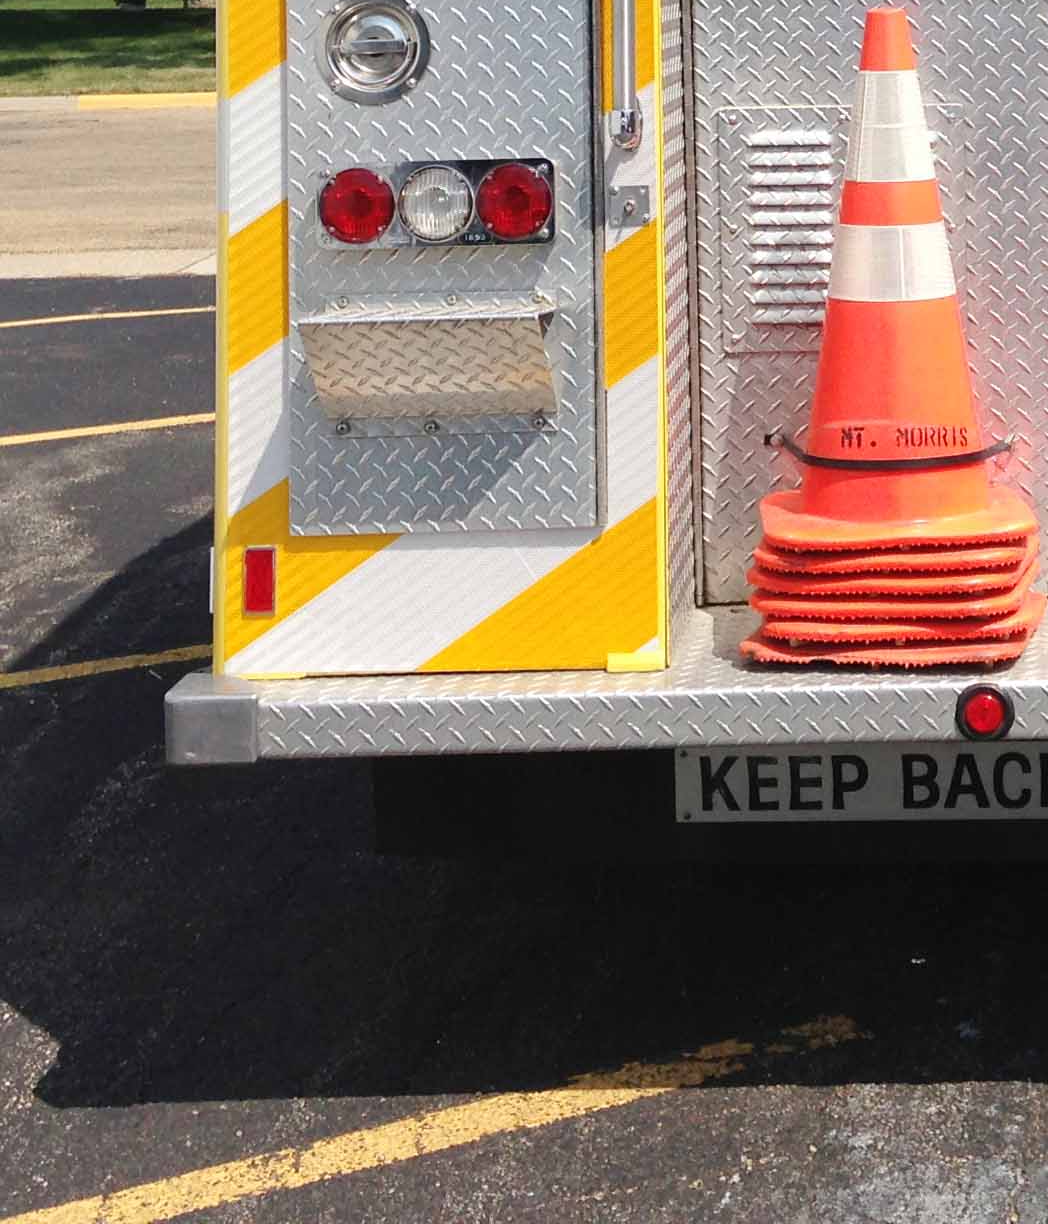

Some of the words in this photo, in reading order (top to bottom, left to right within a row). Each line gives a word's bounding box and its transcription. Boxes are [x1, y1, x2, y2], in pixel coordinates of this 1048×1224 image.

[840, 427, 877, 449] MT.
[896, 426, 968, 448] MORRIS
[699, 754, 869, 812] KEEP
